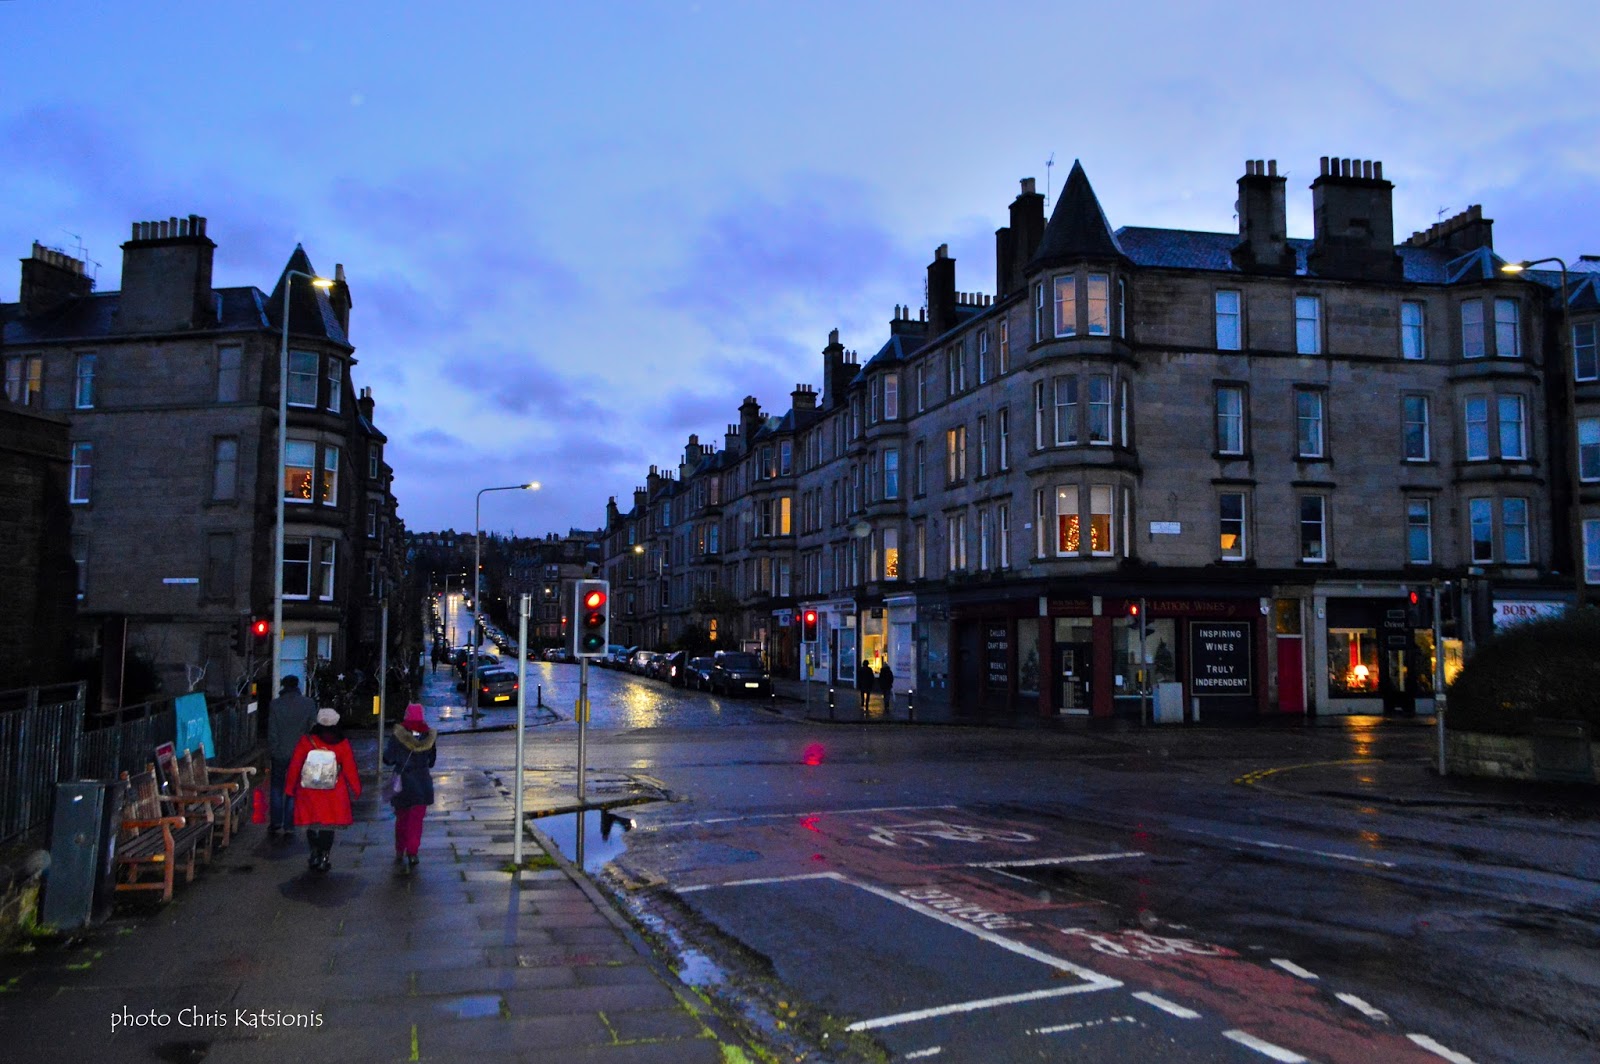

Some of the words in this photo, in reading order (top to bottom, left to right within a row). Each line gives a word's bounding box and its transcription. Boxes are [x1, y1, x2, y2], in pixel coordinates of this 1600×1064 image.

[1122, 599, 1190, 611] ALATION
[1194, 600, 1225, 611] WINES
[1502, 605, 1536, 615] BOB'S
[1199, 629, 1242, 638] INSPIRING
[1205, 642, 1235, 651] WINES
[1206, 664, 1235, 673] TRULY
[1195, 677, 1248, 687] INDEPENDENT
